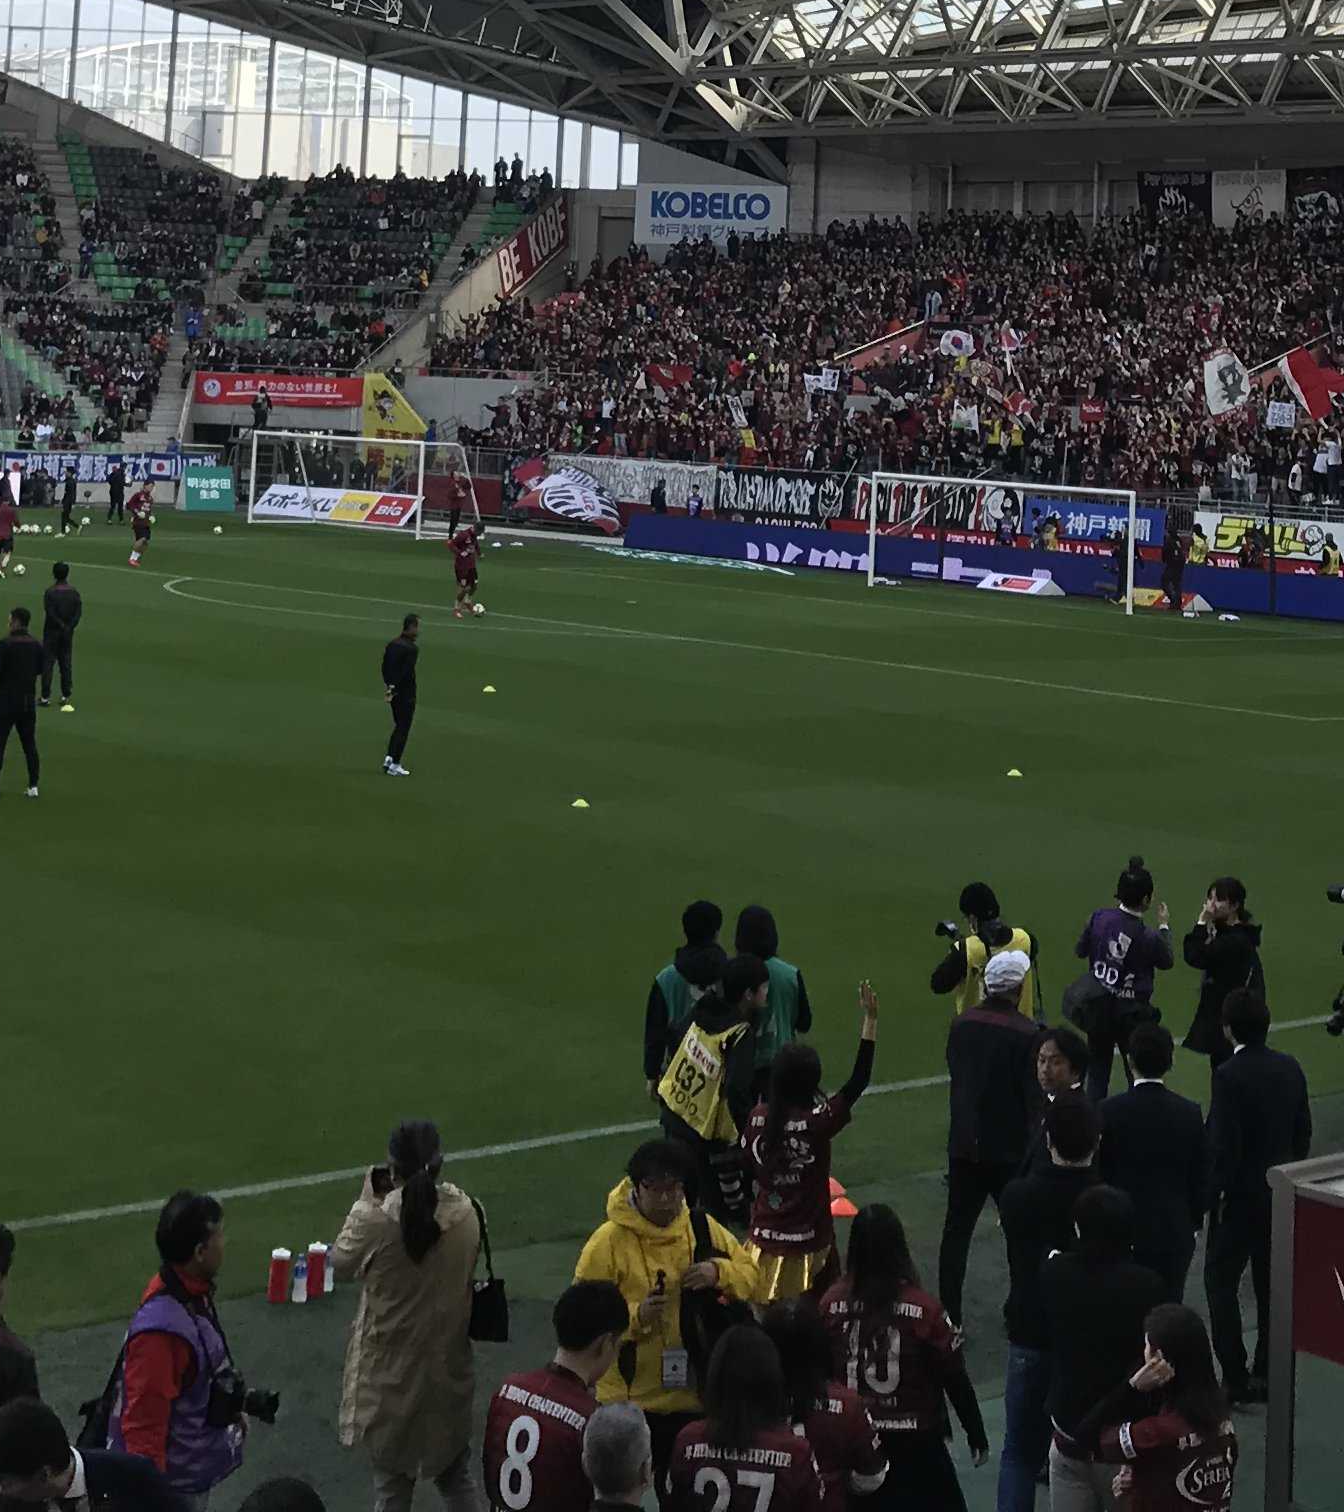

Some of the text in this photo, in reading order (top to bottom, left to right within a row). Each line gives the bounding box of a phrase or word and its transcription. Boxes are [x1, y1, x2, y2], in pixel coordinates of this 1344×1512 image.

[650, 191, 771, 221] KOBELCO
[187, 477, 231, 489] 明治安田
[199, 490, 220, 500] 生命
[499, 1414, 541, 1510] 8
